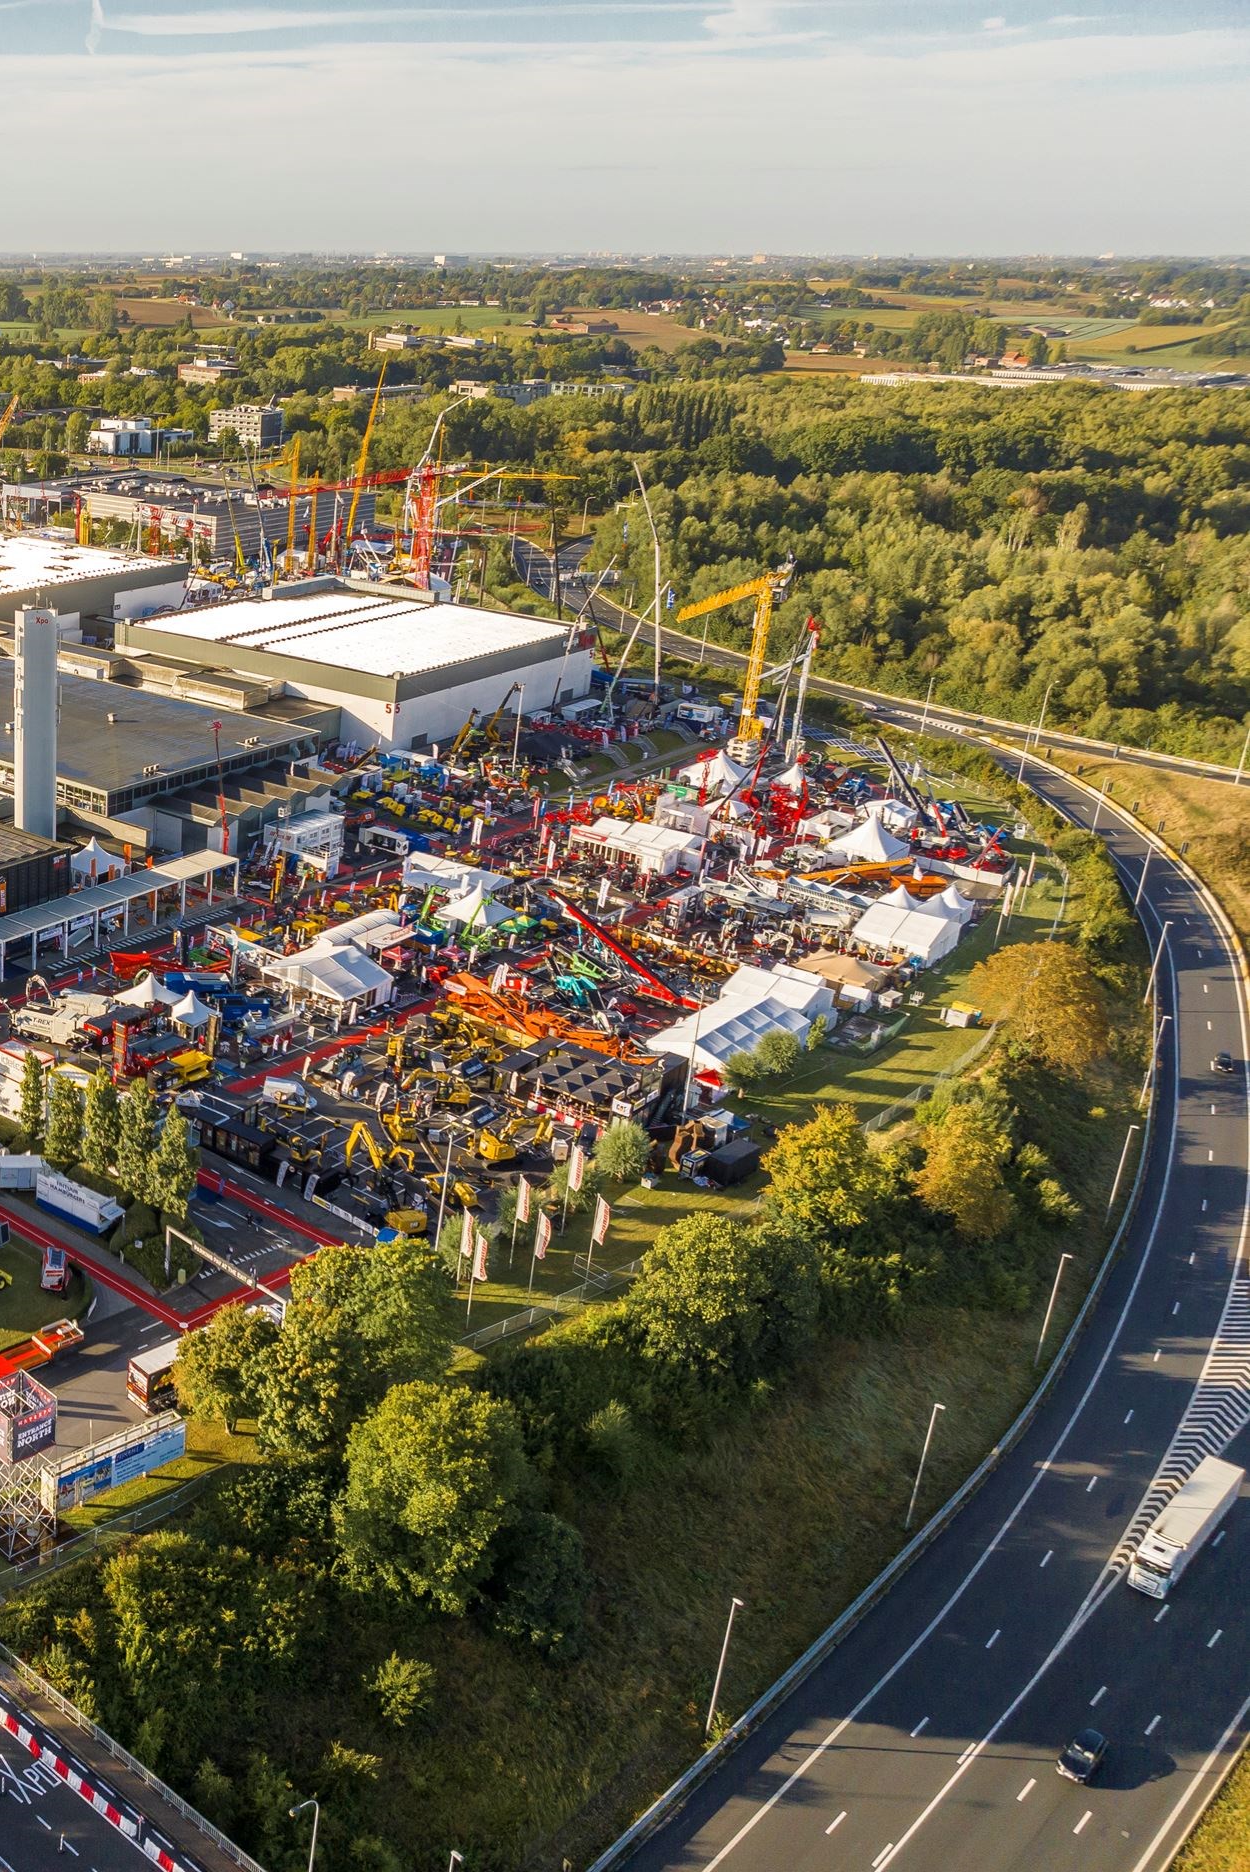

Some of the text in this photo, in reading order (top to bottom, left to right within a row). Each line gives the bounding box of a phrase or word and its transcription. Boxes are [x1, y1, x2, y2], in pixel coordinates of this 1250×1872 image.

[36, 617, 49, 626] Xpo
[385, 704, 392, 714] 5
[18, 1407, 52, 1426] MATEXPO
[16, 1425, 52, 1448] NORTH
[17, 1418, 52, 1440] ENTRANCE
